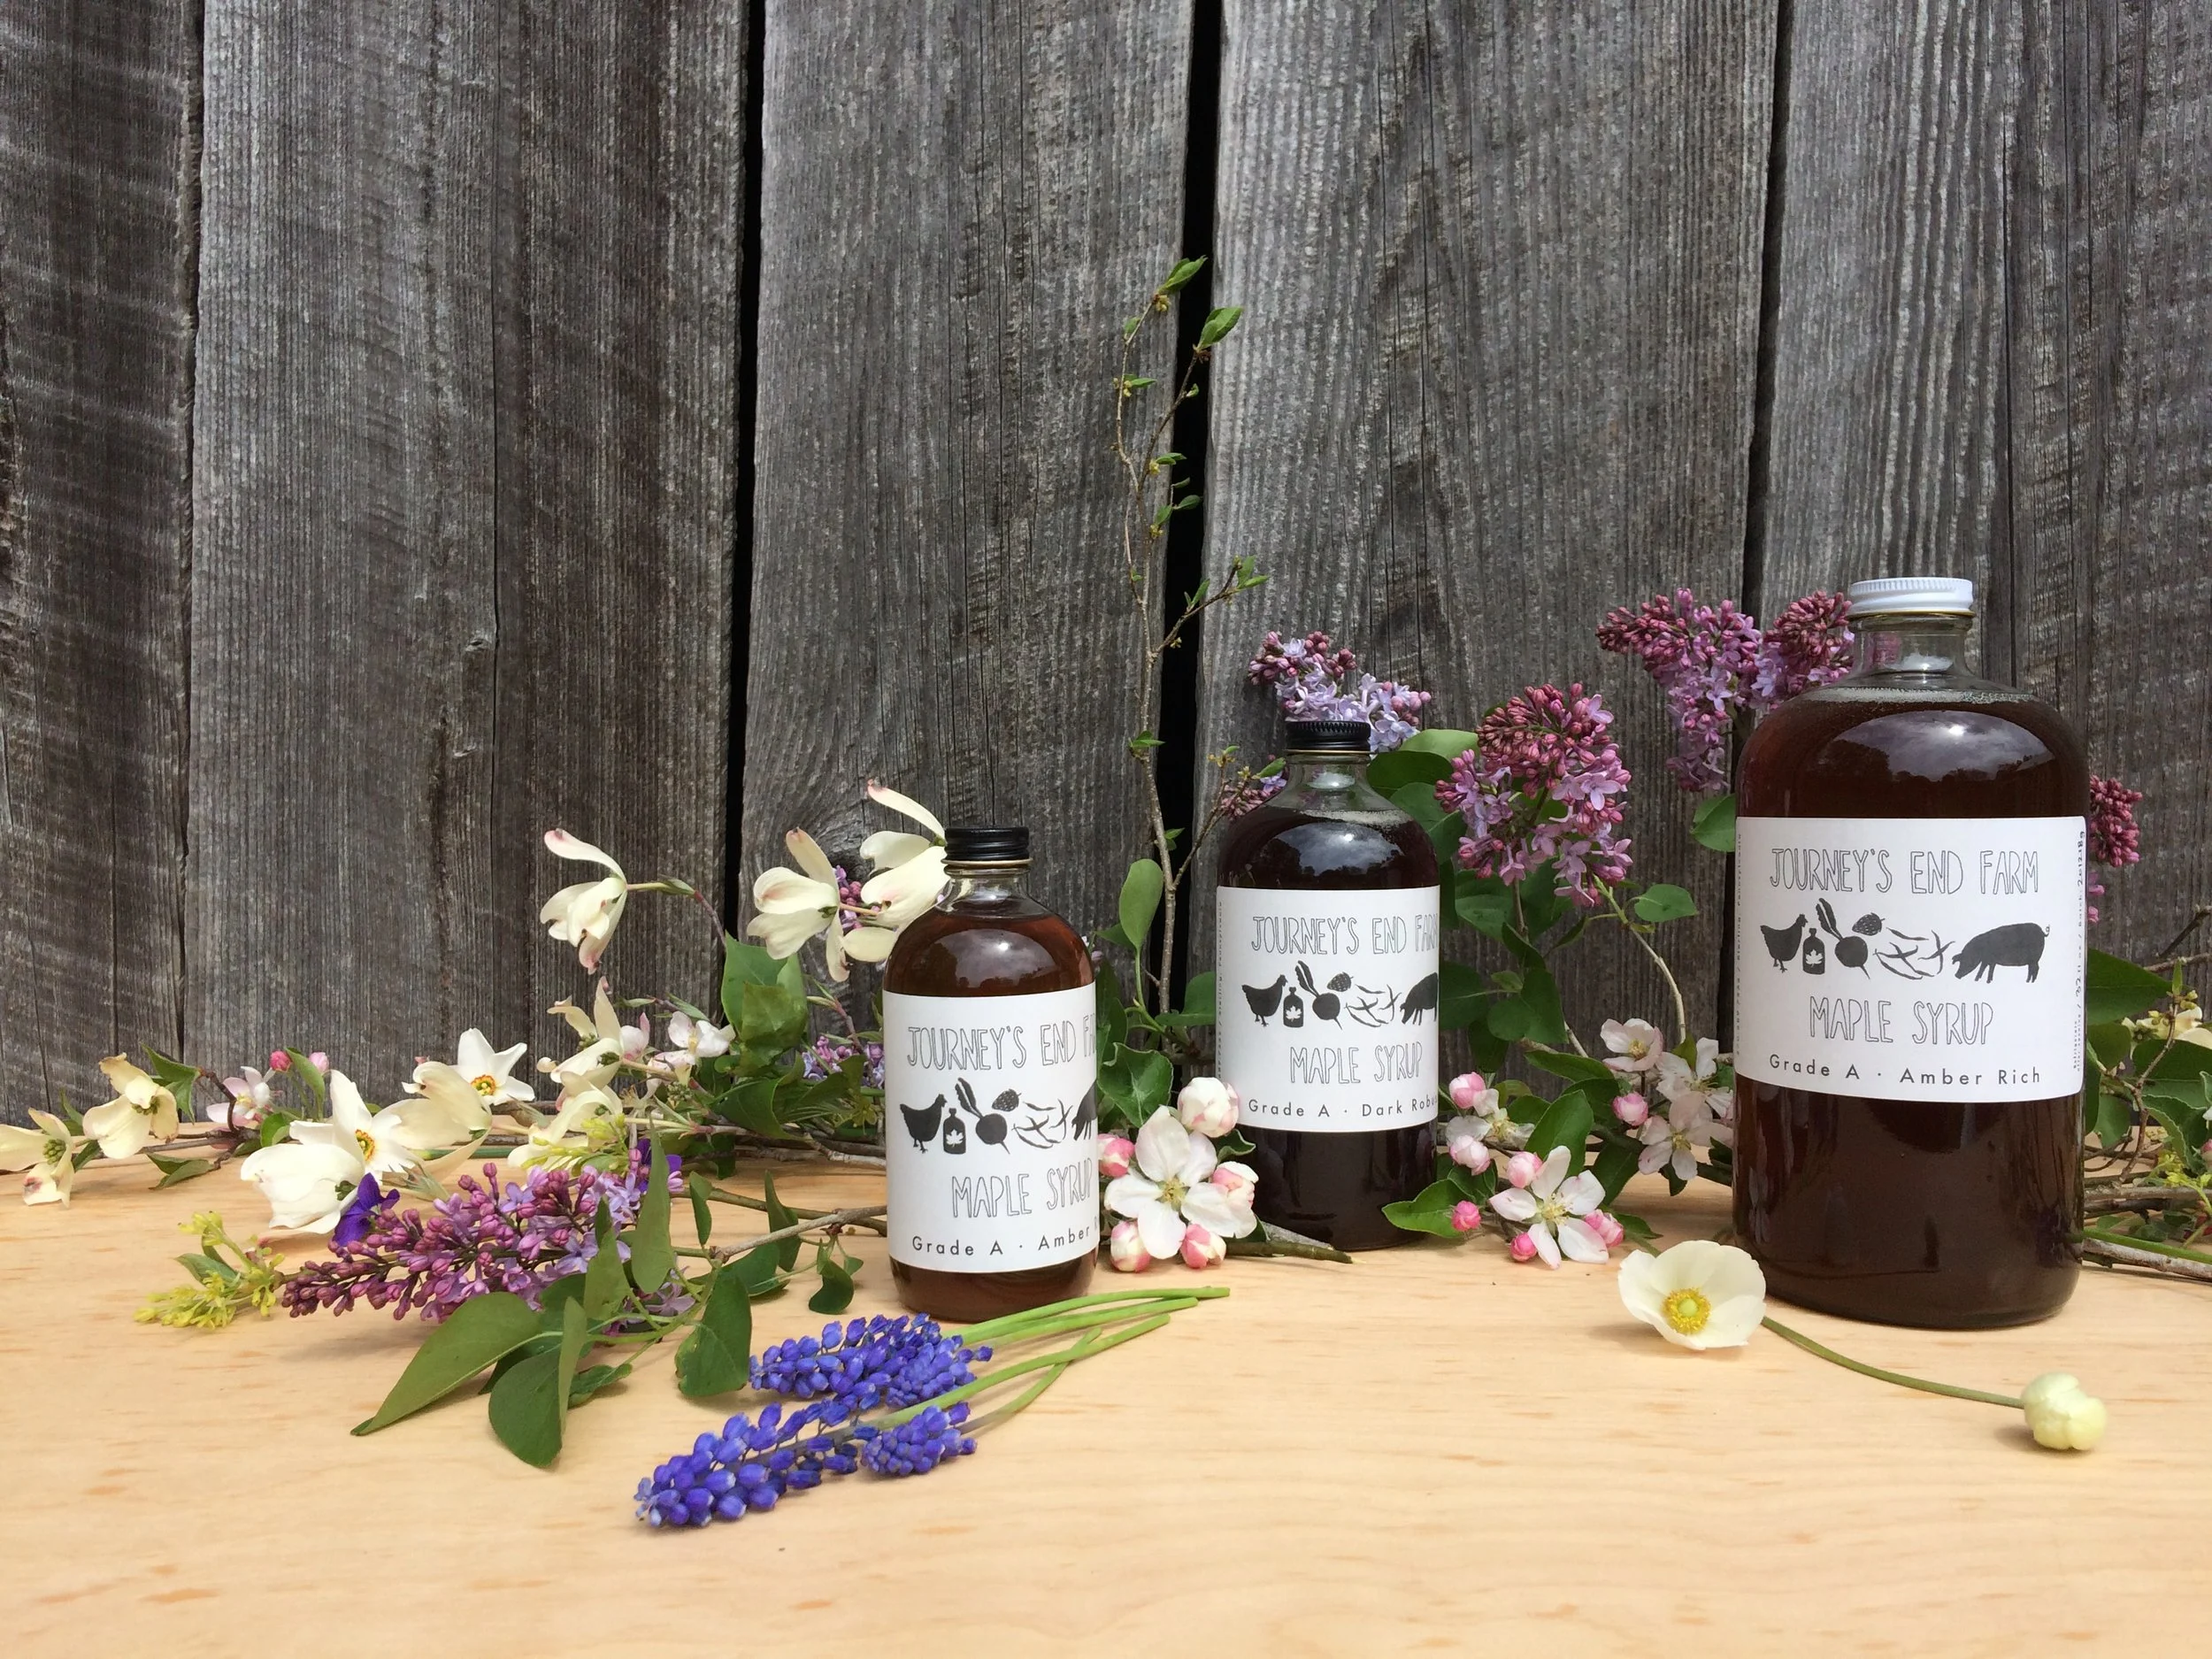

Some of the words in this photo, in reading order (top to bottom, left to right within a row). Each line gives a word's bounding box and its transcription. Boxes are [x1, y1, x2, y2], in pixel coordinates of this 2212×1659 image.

[1770, 848, 1893, 894] JOURNEY'S
[1910, 849, 1963, 895] END
[1979, 849, 2039, 895] FARM
[1250, 915, 1360, 956] JOURNEY'S
[1371, 916, 1408, 956] END
[1809, 995, 1893, 1043] MAPLE
[1911, 1001, 1993, 1046] SYRUP
[907, 1025, 1027, 1071] JOURNEY'S
[1040, 1019, 1077, 1067] END
[1289, 1047, 1361, 1085] MAPLE
[1373, 1041, 1423, 1083] SYRUP
[1770, 1053, 1831, 1078] Grade
[1845, 1064, 1861, 1080] A
[1899, 1067, 1982, 1086] Amber
[1998, 1067, 2040, 1085] Rich
[1248, 1098, 1305, 1118] Grade
[1317, 1103, 1330, 1118] A
[1362, 1099, 1403, 1118] Dark
[952, 1173, 1033, 1218] MAPLE
[1046, 1156, 1093, 1211] SYRUP
[911, 1235, 974, 1256] Grade
[989, 1240, 1003, 1256] A
[1038, 1226, 1090, 1251] Amber
